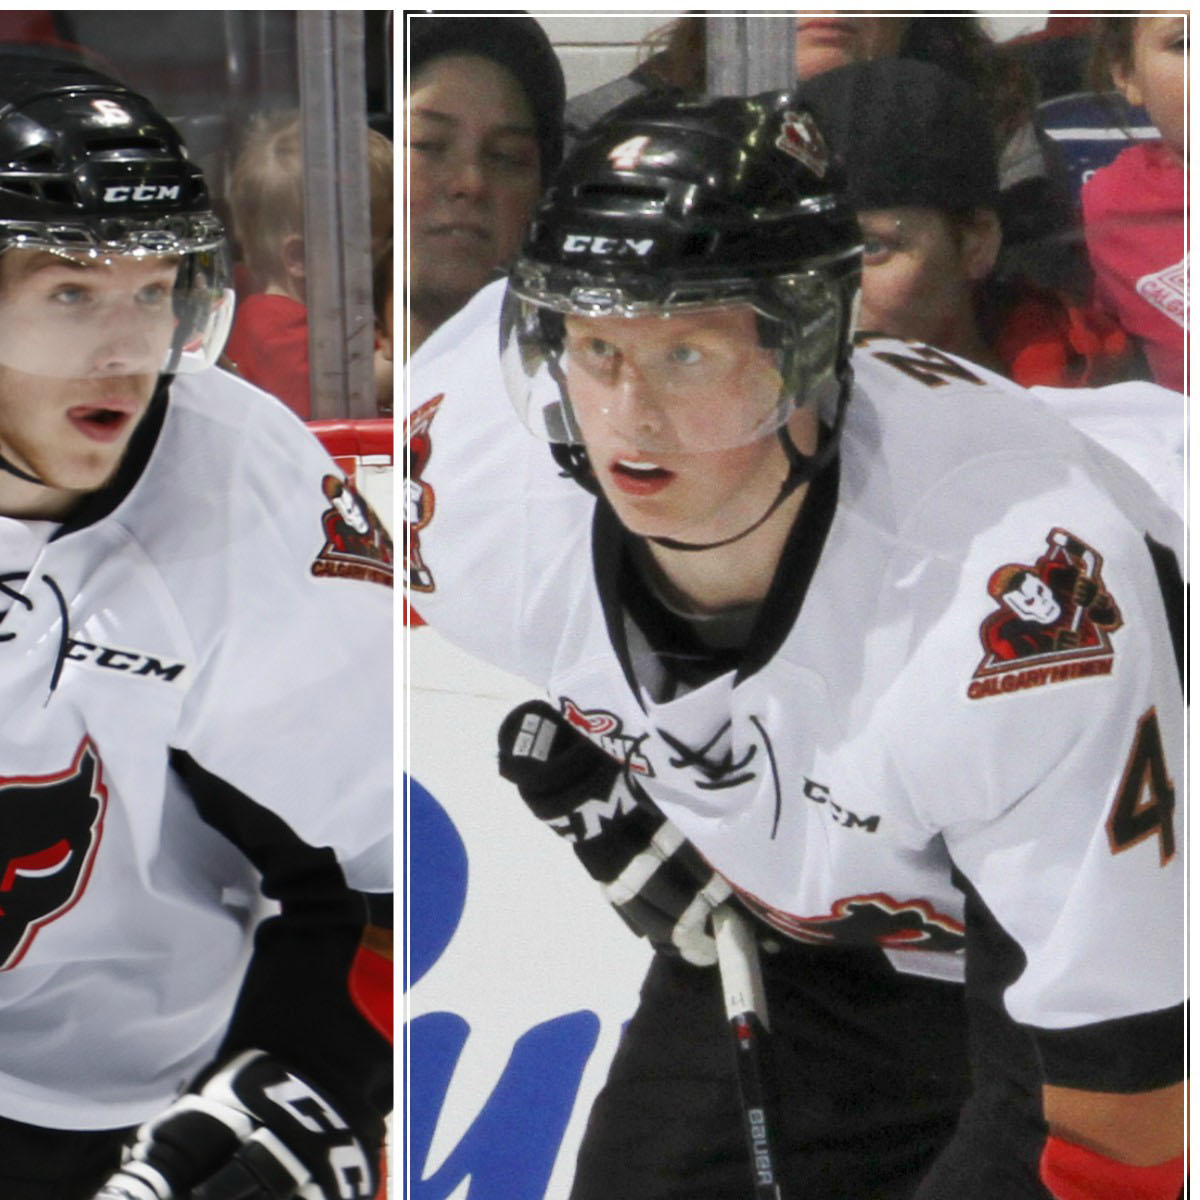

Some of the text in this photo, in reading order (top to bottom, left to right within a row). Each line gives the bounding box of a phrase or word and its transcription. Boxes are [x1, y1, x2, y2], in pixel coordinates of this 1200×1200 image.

[608, 135, 651, 171] 4
[103, 185, 180, 203] CCM
[563, 235, 655, 256] CCM
[62, 638, 186, 682] CCM
[1105, 706, 1176, 868] 4
[749, 1108, 774, 1186] BAUER
